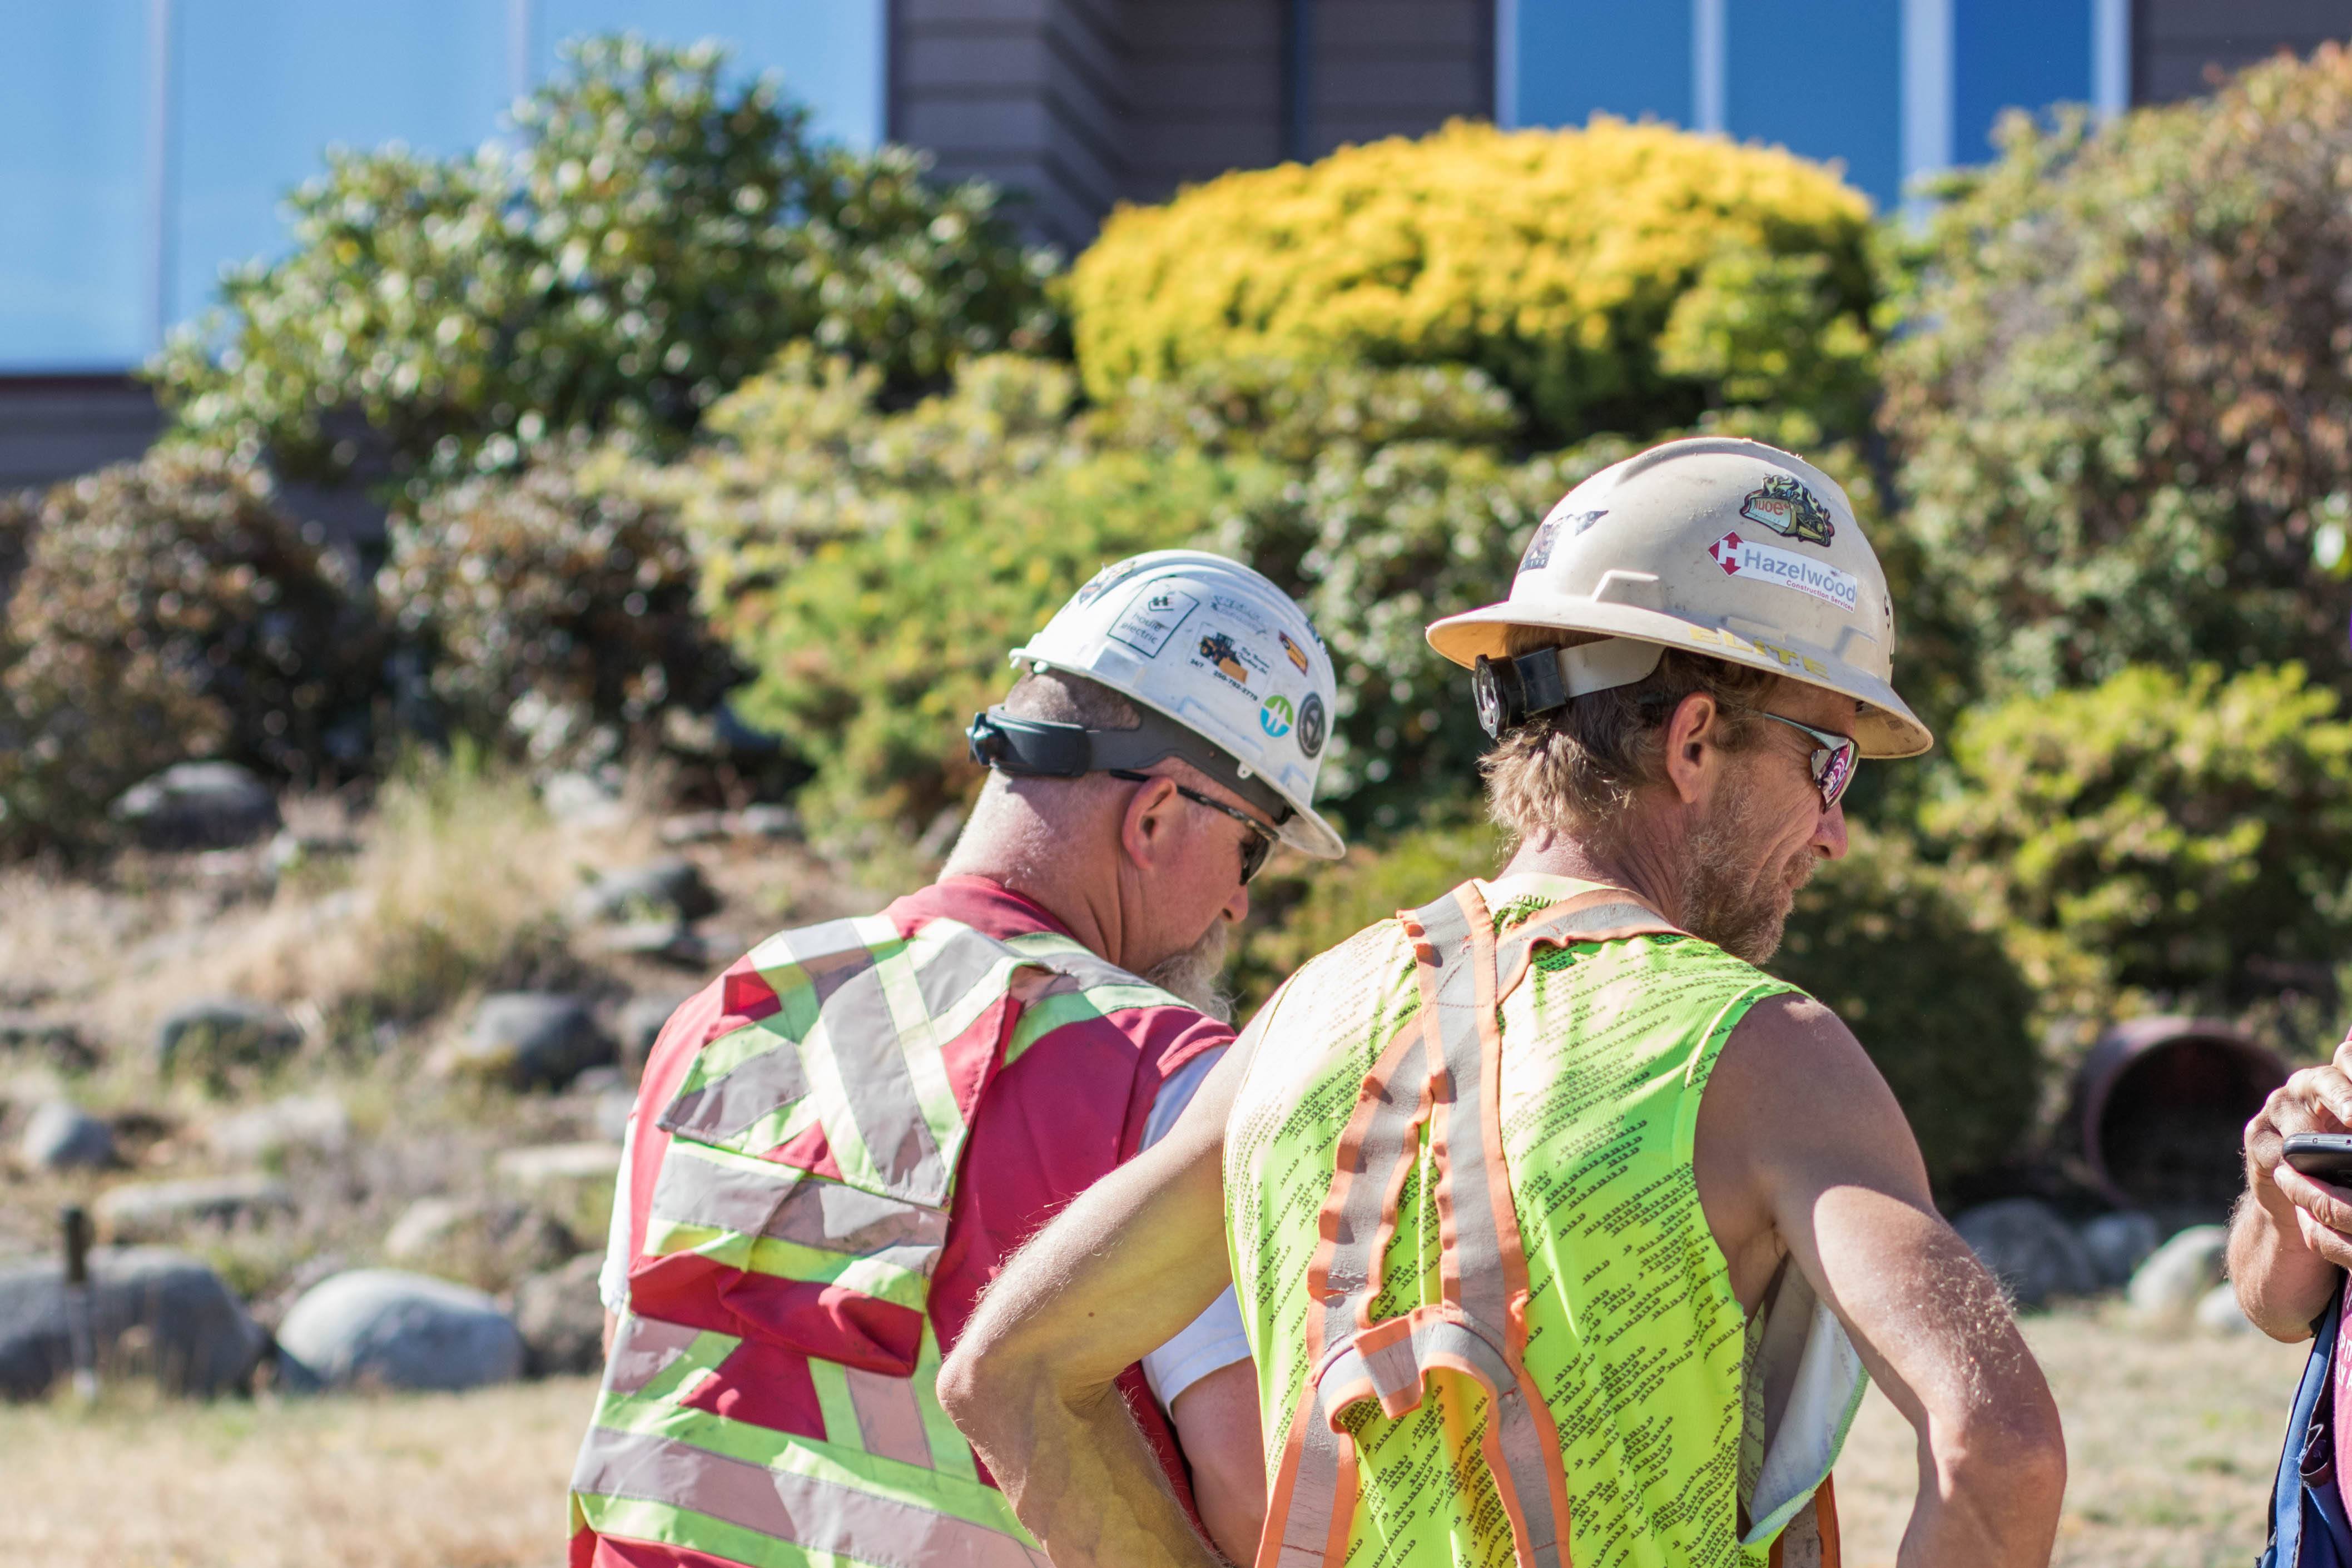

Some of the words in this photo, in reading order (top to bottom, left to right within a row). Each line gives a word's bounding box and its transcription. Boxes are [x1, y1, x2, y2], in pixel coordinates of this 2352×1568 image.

[1744, 549, 1857, 603] Hazelwood
[1786, 580, 1829, 600] Construction
[1830, 596, 1854, 612] Services
[1120, 622, 1158, 644] electric
[1688, 626, 1830, 680] ELITE
